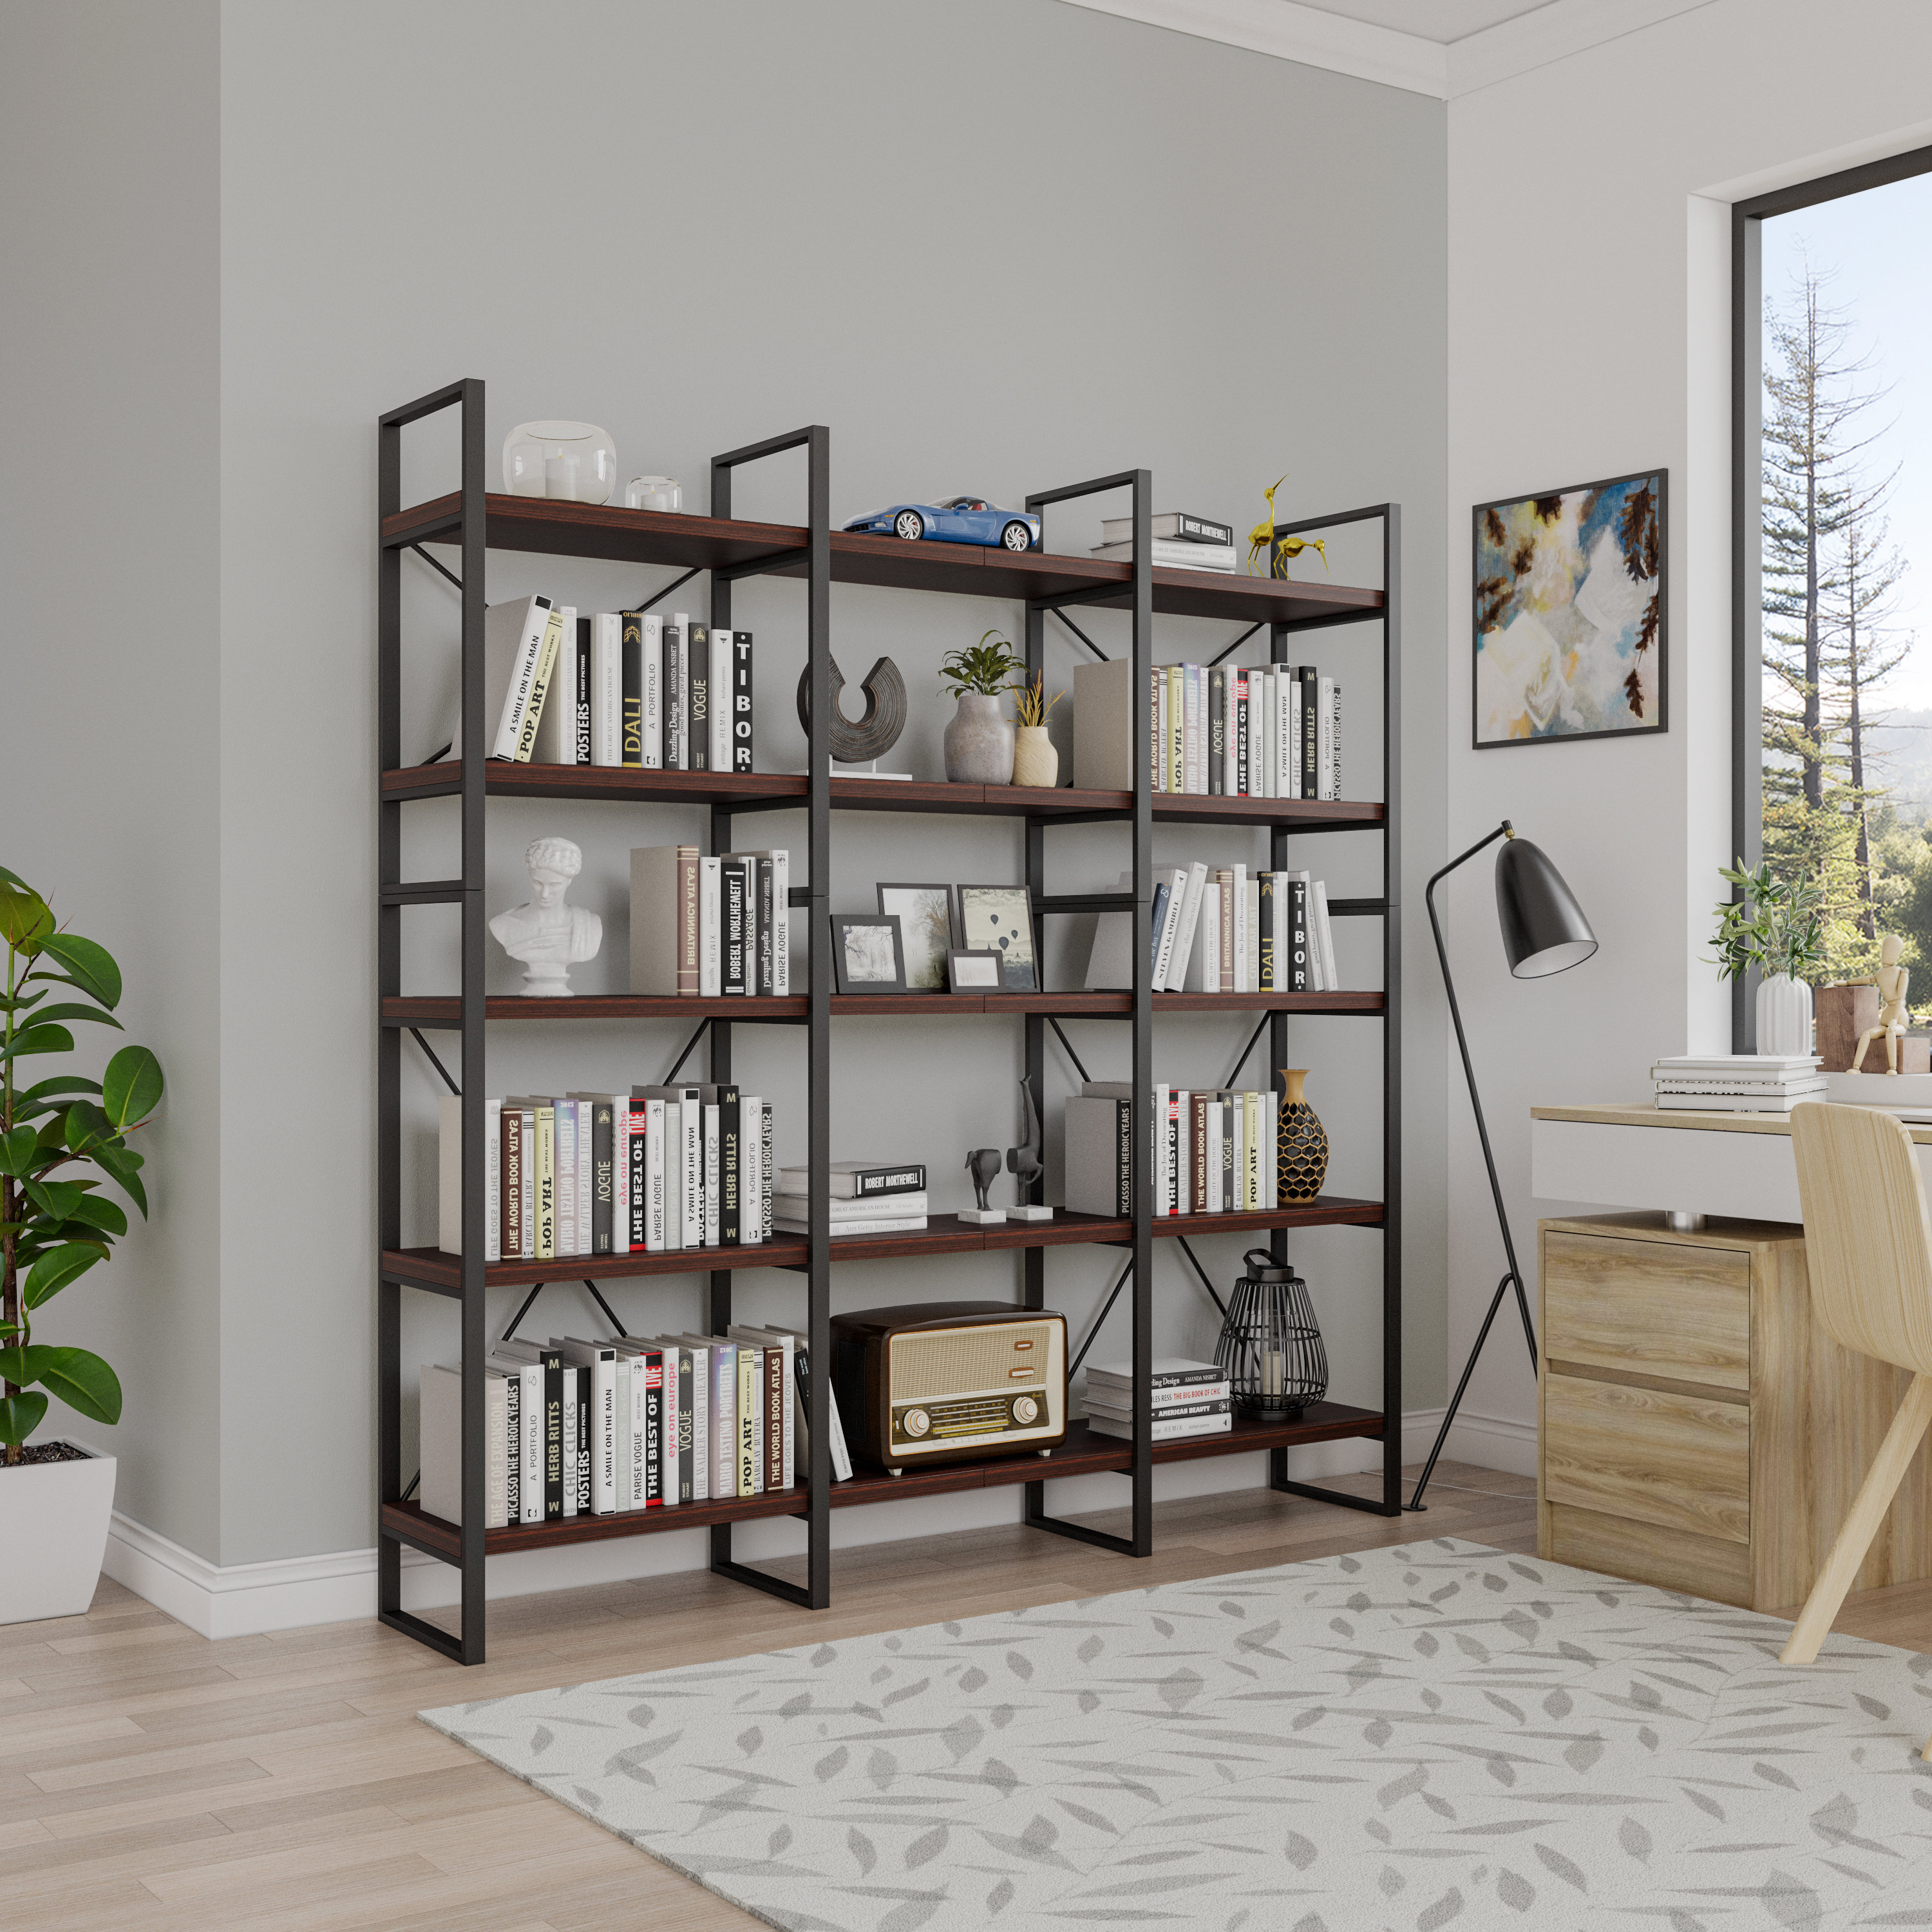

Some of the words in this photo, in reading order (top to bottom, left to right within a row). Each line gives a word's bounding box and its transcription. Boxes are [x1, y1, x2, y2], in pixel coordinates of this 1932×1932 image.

[1186, 520, 1200, 533] ROBERT
[1202, 525, 1226, 540] MORTHEWELL
[528, 636, 539, 658] MAN
[523, 659, 533, 677] THE
[520, 680, 528, 694] ON
[694, 680, 706, 720] VOGUE
[512, 696, 524, 723] SMILE
[520, 720, 535, 753] POP
[529, 681, 545, 716] ART
[668, 702, 679, 728] Design
[735, 643, 752, 764] TIBOR
[577, 703, 589, 761] POSTERS
[625, 698, 641, 752] DALI
[669, 729, 679, 761] Dazzling
[1294, 890, 1305, 984] TIBOR
[1262, 938, 1274, 979] DALI
[1222, 1137, 1232, 1170] VOGUE
[866, 1176, 884, 1189] ROBERT
[886, 1173, 918, 1186] MORTHEWELL
[668, 1363, 677, 1410] europe
[696, 1359, 706, 1402] THEATER
[772, 1358, 780, 1388] ATLAS
[1163, 1378, 1180, 1386] Design
[509, 1386, 518, 1417] YEARS
[648, 1395, 657, 1416] OF
[772, 1391, 780, 1420] BOOK
[1159, 1408, 1188, 1417] AMERICAN
[1189, 1405, 1210, 1414] BEAUTY
[491, 1402, 504, 1461] EXPANSION
[509, 1418, 518, 1454] HEROIC
[549, 1401, 559, 1440] RITTS
[565, 1402, 576, 1453] CLICKS
[668, 1414, 675, 1431] on
[679, 1410, 692, 1451] VOGUE
[696, 1406, 706, 1435] STORY
[743, 1418, 752, 1450] ART
[784, 1426, 791, 1438] TO
[605, 1434, 612, 1447] ON
[634, 1432, 642, 1464] VOGUE
[648, 1420, 657, 1460] BEST
[668, 1435, 677, 1457] eye
[696, 1437, 706, 1475] WALKER
[772, 1423, 780, 1460] WORLD
[491, 1464, 504, 1477] OF
[509, 1456, 518, 1475] THE
[549, 1444, 559, 1481] HERB
[565, 1461, 576, 1496] CHIC
[743, 1457, 752, 1486] POP
[772, 1462, 780, 1482] THE
[491, 1480, 504, 1500] AGE
[578, 1451, 589, 1508] POSTERS
[648, 1464, 657, 1497] THE
[696, 1477, 706, 1498] THE
[491, 1502, 504, 1524] THE
[509, 1477, 518, 1518] PICASSO
